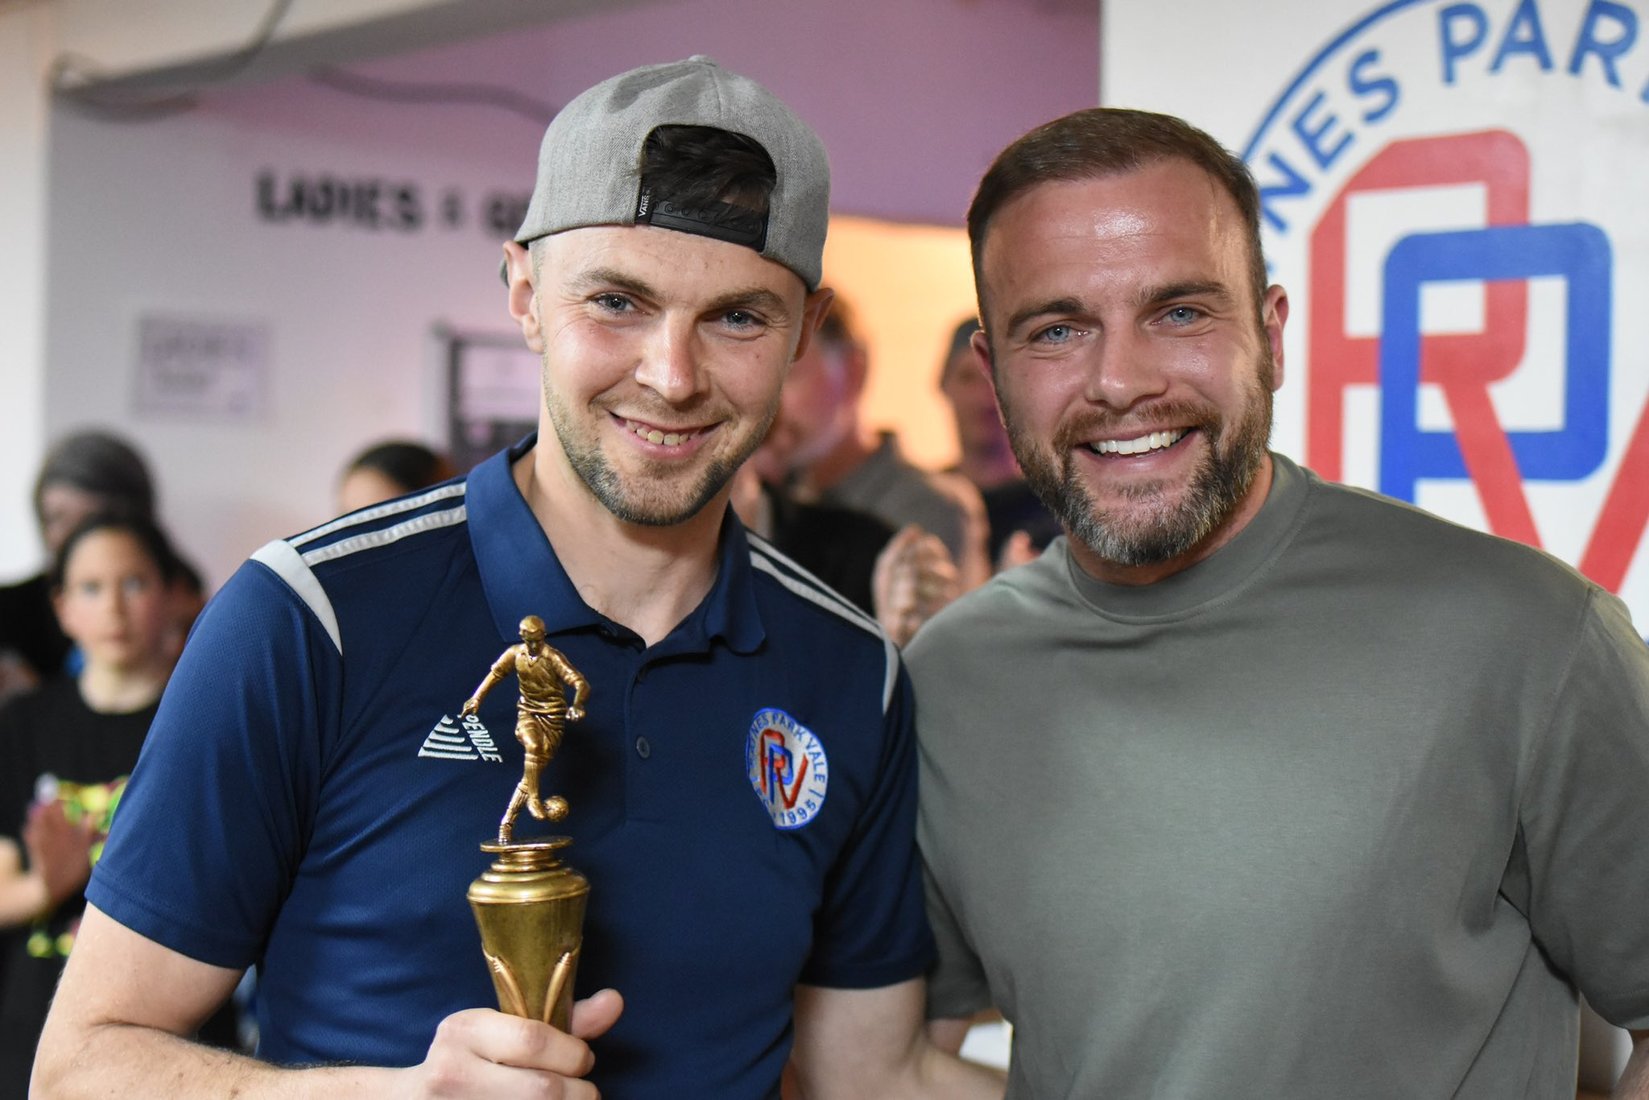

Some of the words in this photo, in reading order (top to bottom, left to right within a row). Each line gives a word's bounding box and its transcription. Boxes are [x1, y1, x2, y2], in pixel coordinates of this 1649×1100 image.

[1260, 50, 1402, 274] NES
[1438, 0, 1649, 104] PAR
[257, 166, 424, 234] LADIES
[638, 195, 649, 217] VANS
[457, 713, 503, 763] PENDLE
[772, 712, 806, 742] PARK
[805, 737, 826, 782] VALE
[781, 799, 817, 825] 1995
